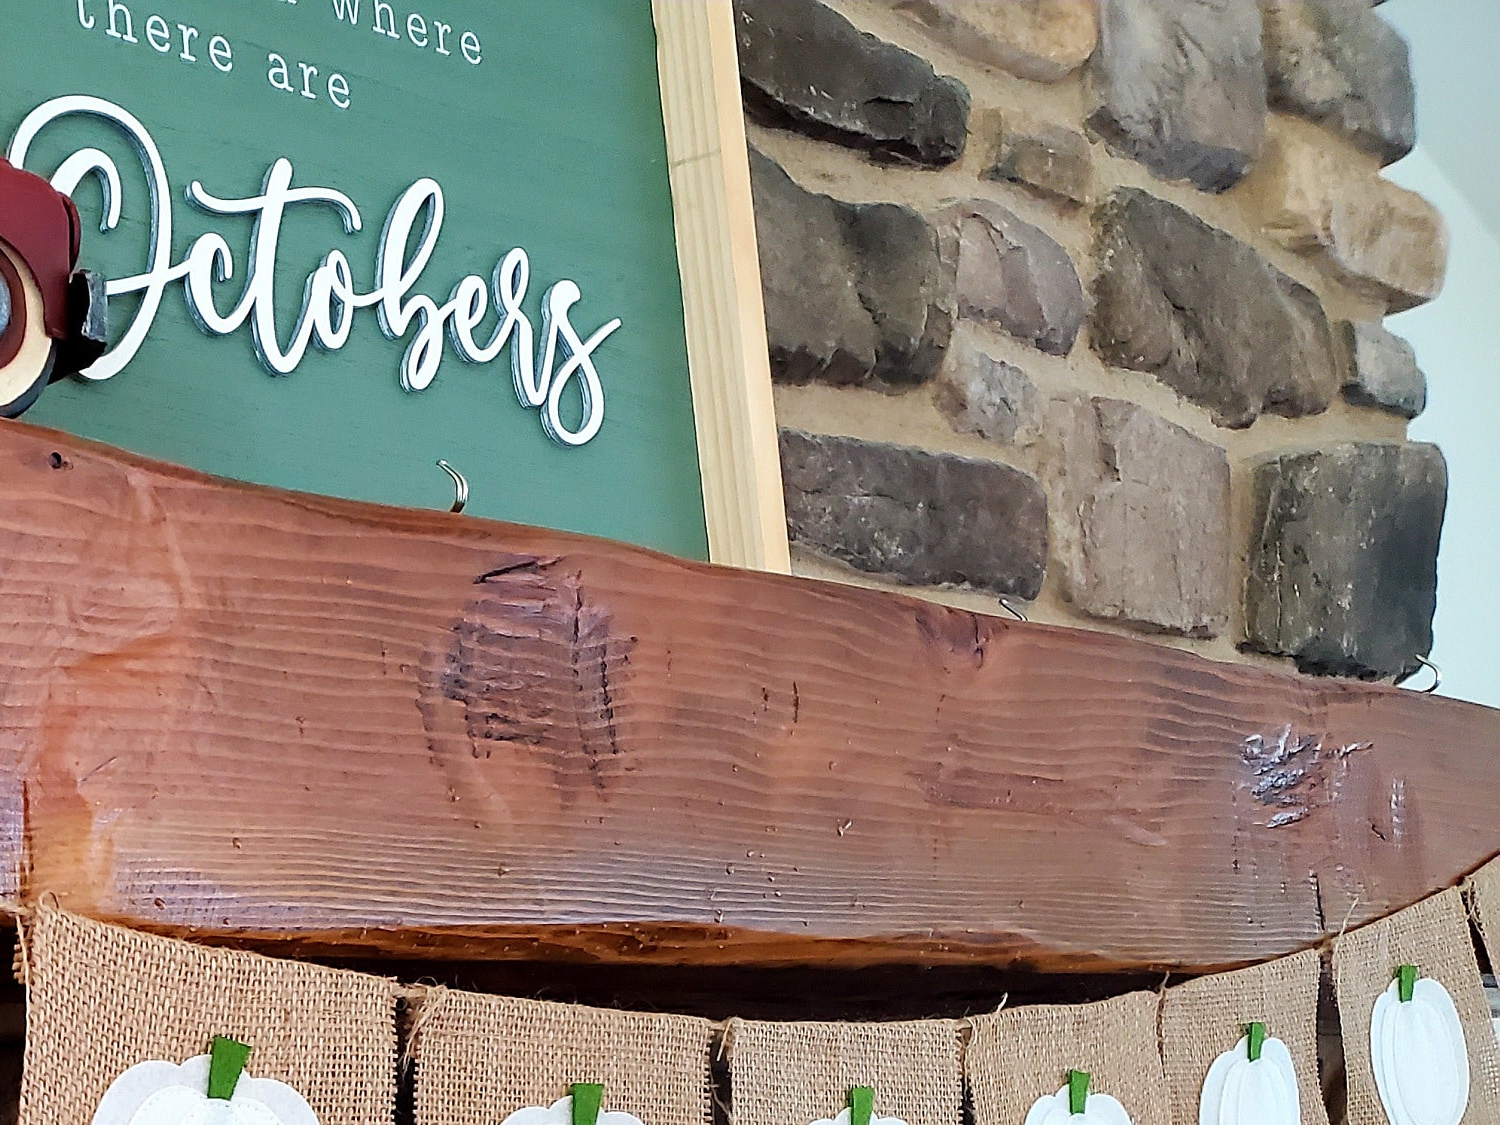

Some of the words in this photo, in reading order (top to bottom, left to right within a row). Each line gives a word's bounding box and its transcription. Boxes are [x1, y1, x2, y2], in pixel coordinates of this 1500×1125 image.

[77, 0, 233, 72] there
[267, 53, 351, 109] are
[332, 0, 482, 65] where
[7, 95, 622, 447] Octobers
